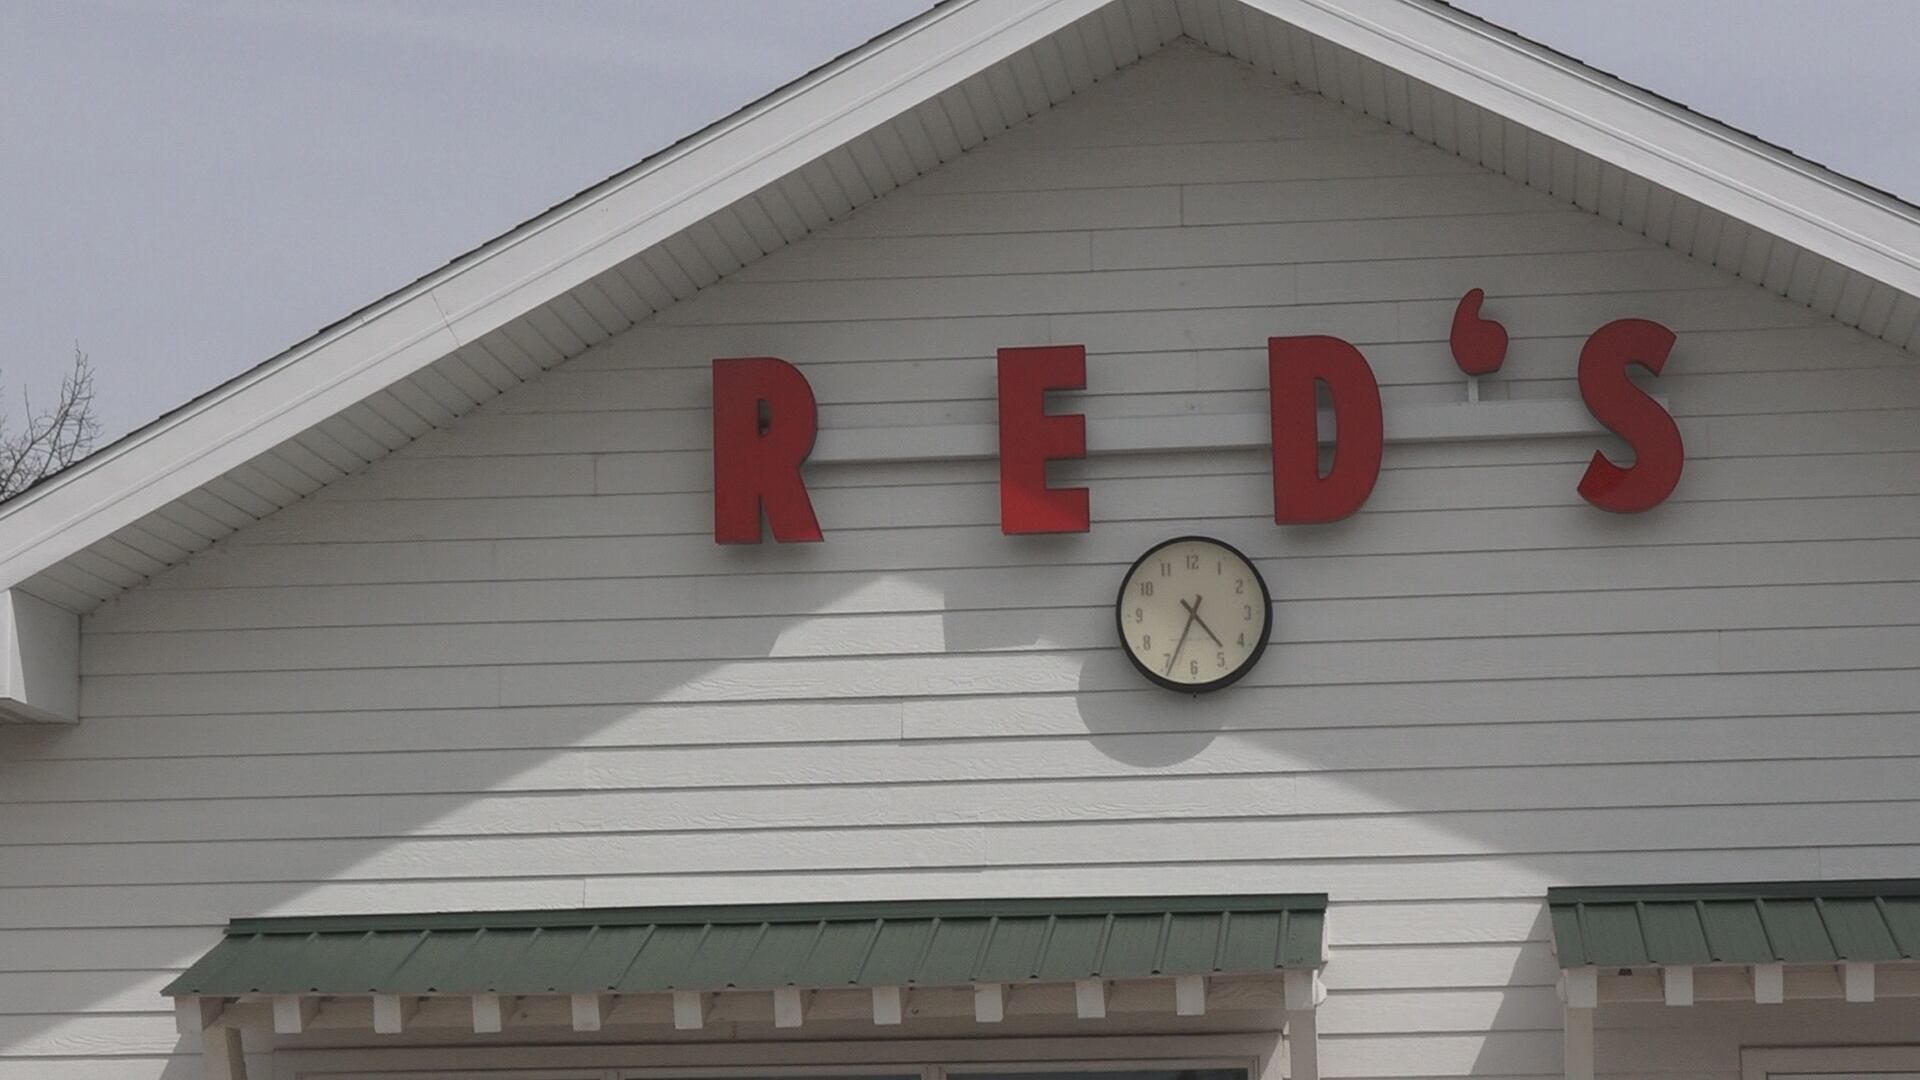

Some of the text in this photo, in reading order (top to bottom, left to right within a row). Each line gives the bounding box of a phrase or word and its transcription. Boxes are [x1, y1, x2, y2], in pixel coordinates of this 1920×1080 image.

[1186, 554, 1199, 570] 12
[1217, 561, 1221, 576] 1
[1161, 563, 1171, 577] 11
[1140, 581, 1153, 596] 10
[1235, 579, 1243, 594] 2
[1135, 608, 1143, 623] 9
[1244, 605, 1251, 621] 3
[1143, 635, 1150, 650] 8
[1236, 632, 1245, 647] 4
[1163, 653, 1171, 668] 7
[1217, 652, 1225, 667] 5
[1190, 660, 1198, 675] 6
